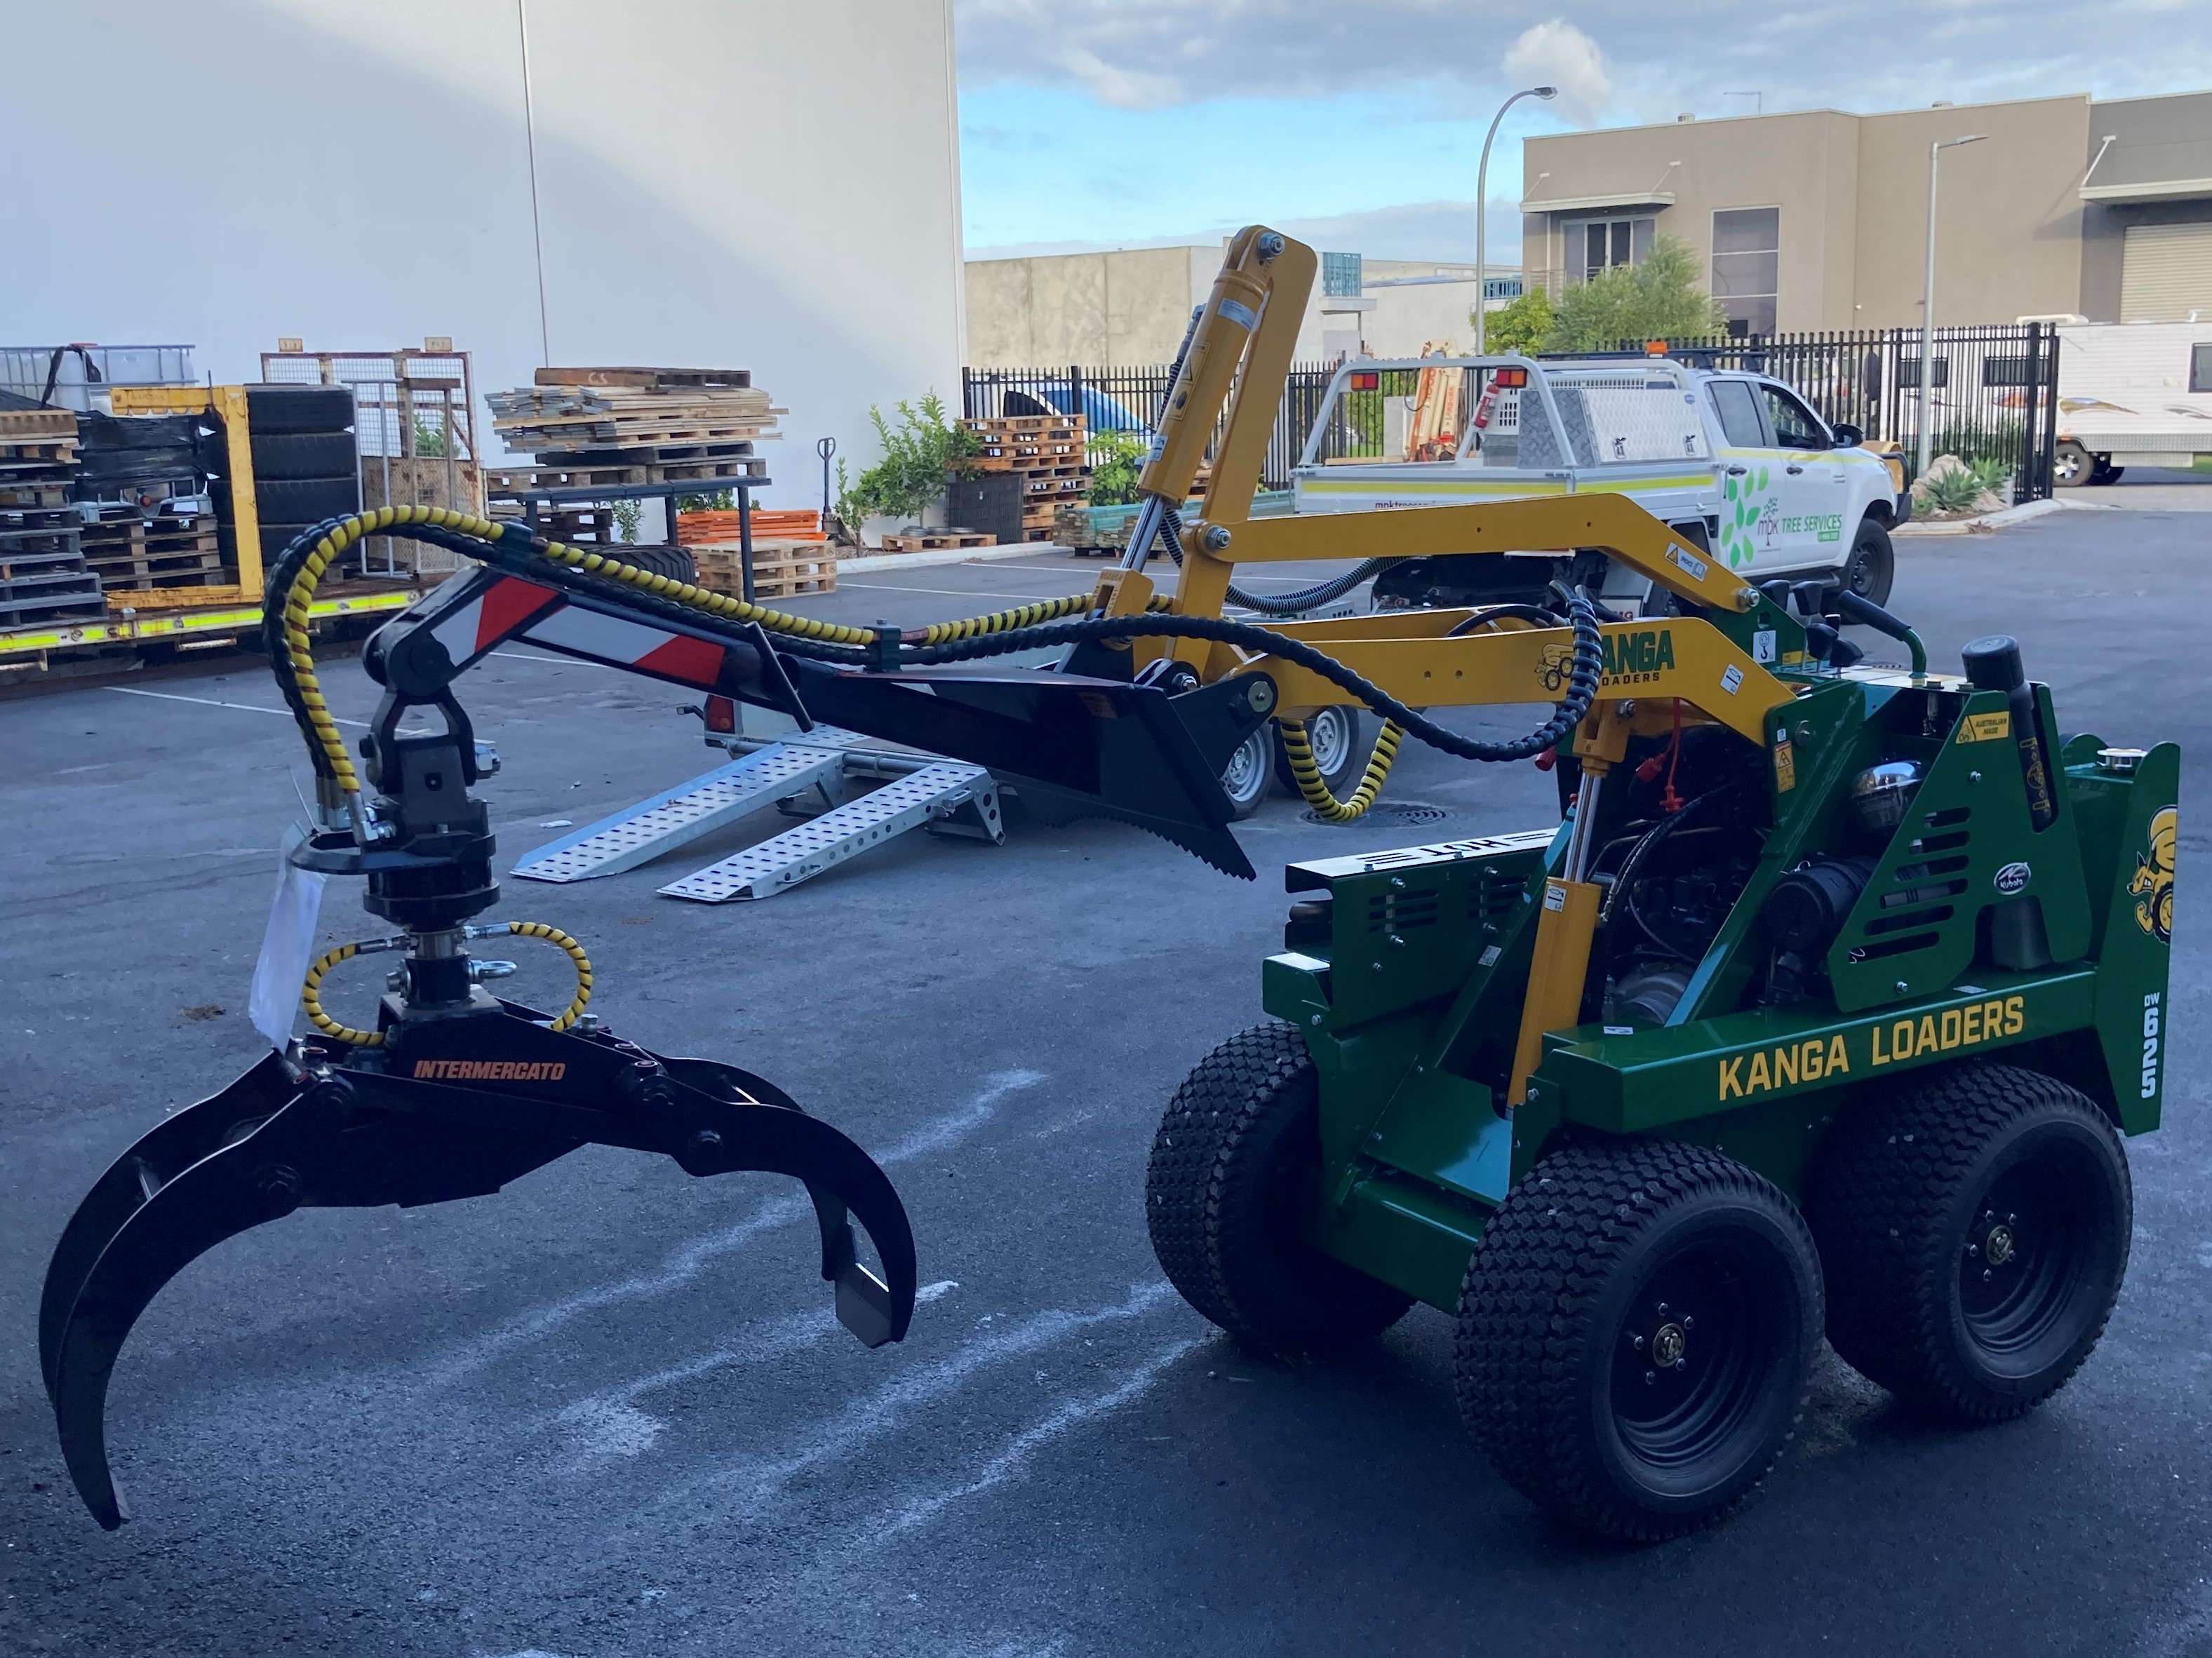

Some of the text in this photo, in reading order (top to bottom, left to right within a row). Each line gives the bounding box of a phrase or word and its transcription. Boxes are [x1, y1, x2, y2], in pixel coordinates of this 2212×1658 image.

[1757, 514, 1842, 540] mpk TREE SERVICES
[1600, 630, 1675, 675] ANGA
[1602, 673, 1660, 686] OADERS
[1975, 717, 2007, 728] AUSTRALIAN
[2000, 877, 2023, 889] Kubota
[2144, 992, 2160, 1007] DW
[1719, 996, 2024, 1101] KANGA LOADERS
[2141, 1006, 2159, 1098] 625
[414, 1060, 565, 1081] INTERMERCATO
